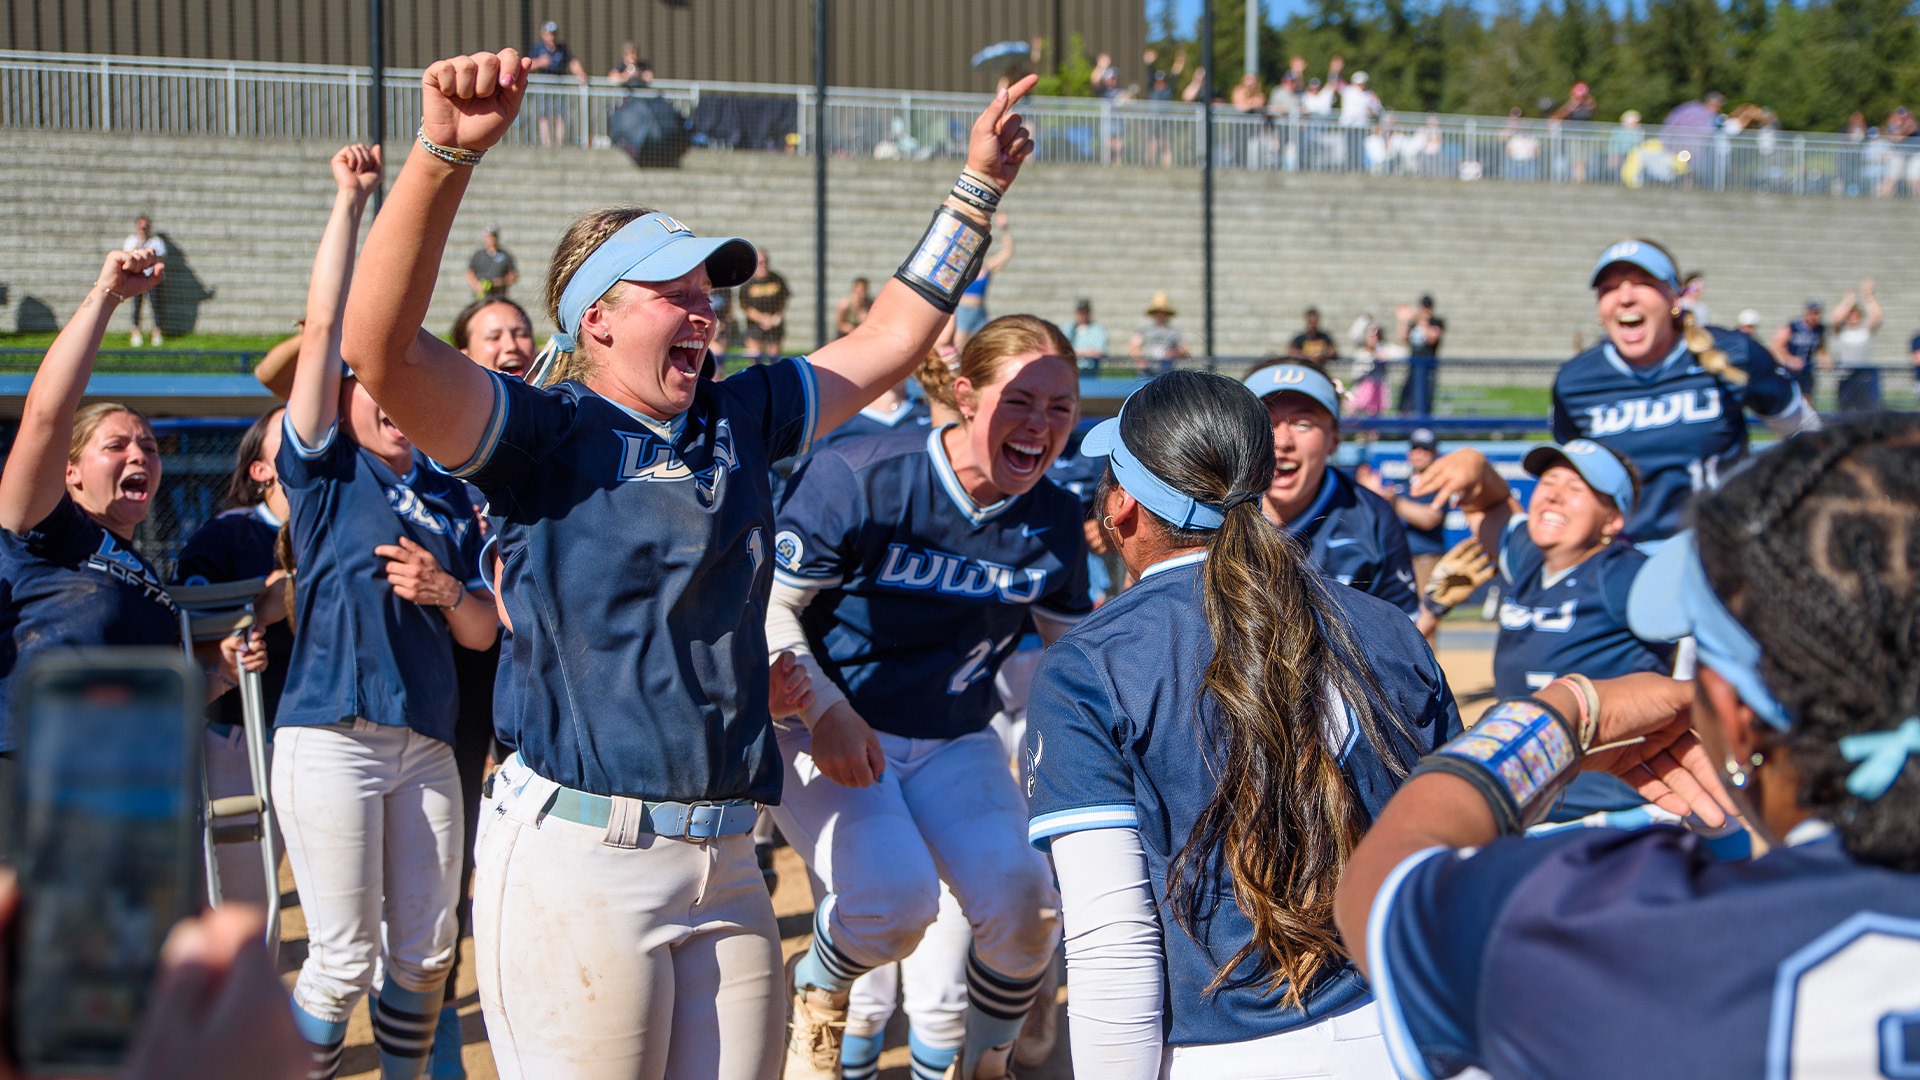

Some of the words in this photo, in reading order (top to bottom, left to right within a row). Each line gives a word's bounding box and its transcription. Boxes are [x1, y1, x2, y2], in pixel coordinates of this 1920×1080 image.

[957, 179, 982, 196] WWU
[1273, 368, 1306, 385] W
[1584, 388, 1724, 438] WWU
[876, 543, 1048, 604] WWU
